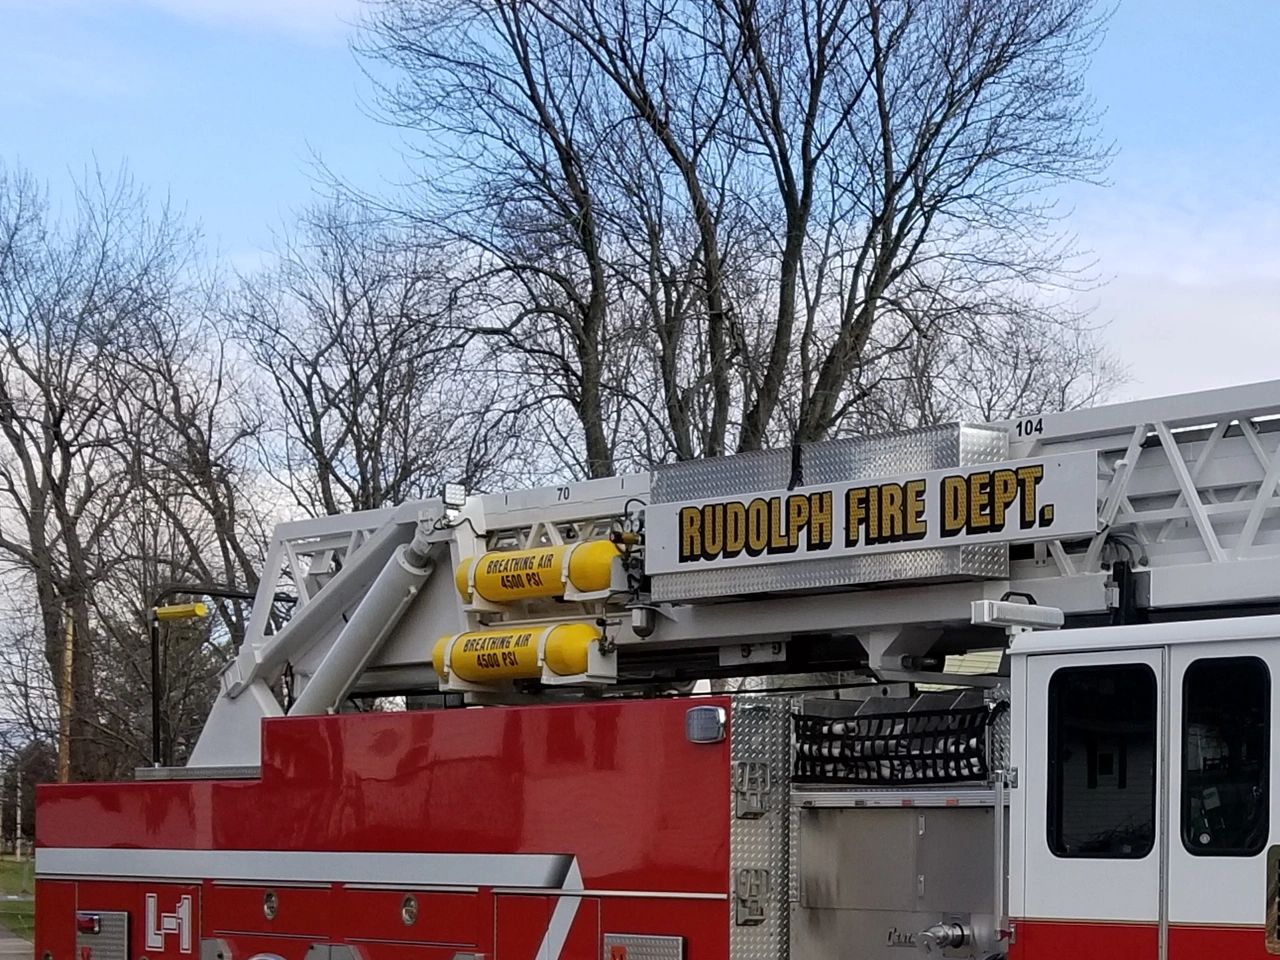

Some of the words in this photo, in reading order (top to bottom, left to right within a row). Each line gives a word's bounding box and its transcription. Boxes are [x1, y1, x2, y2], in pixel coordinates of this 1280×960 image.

[1015, 417, 1044, 438] 104
[556, 486, 571, 502] 70
[679, 491, 833, 563] RUDOLPH
[845, 479, 927, 548] FIRE
[940, 464, 1055, 539] DEPT.
[486, 556, 536, 575] BREATHING
[537, 553, 554, 569] AIR
[500, 573, 525, 590] 4500
[525, 572, 544, 588] PSI
[463, 635, 514, 653] BREATHING
[513, 633, 532, 648] AIR
[476, 652, 501, 670] 4500
[501, 651, 519, 667] PSI
[145, 893, 192, 954] L-1
